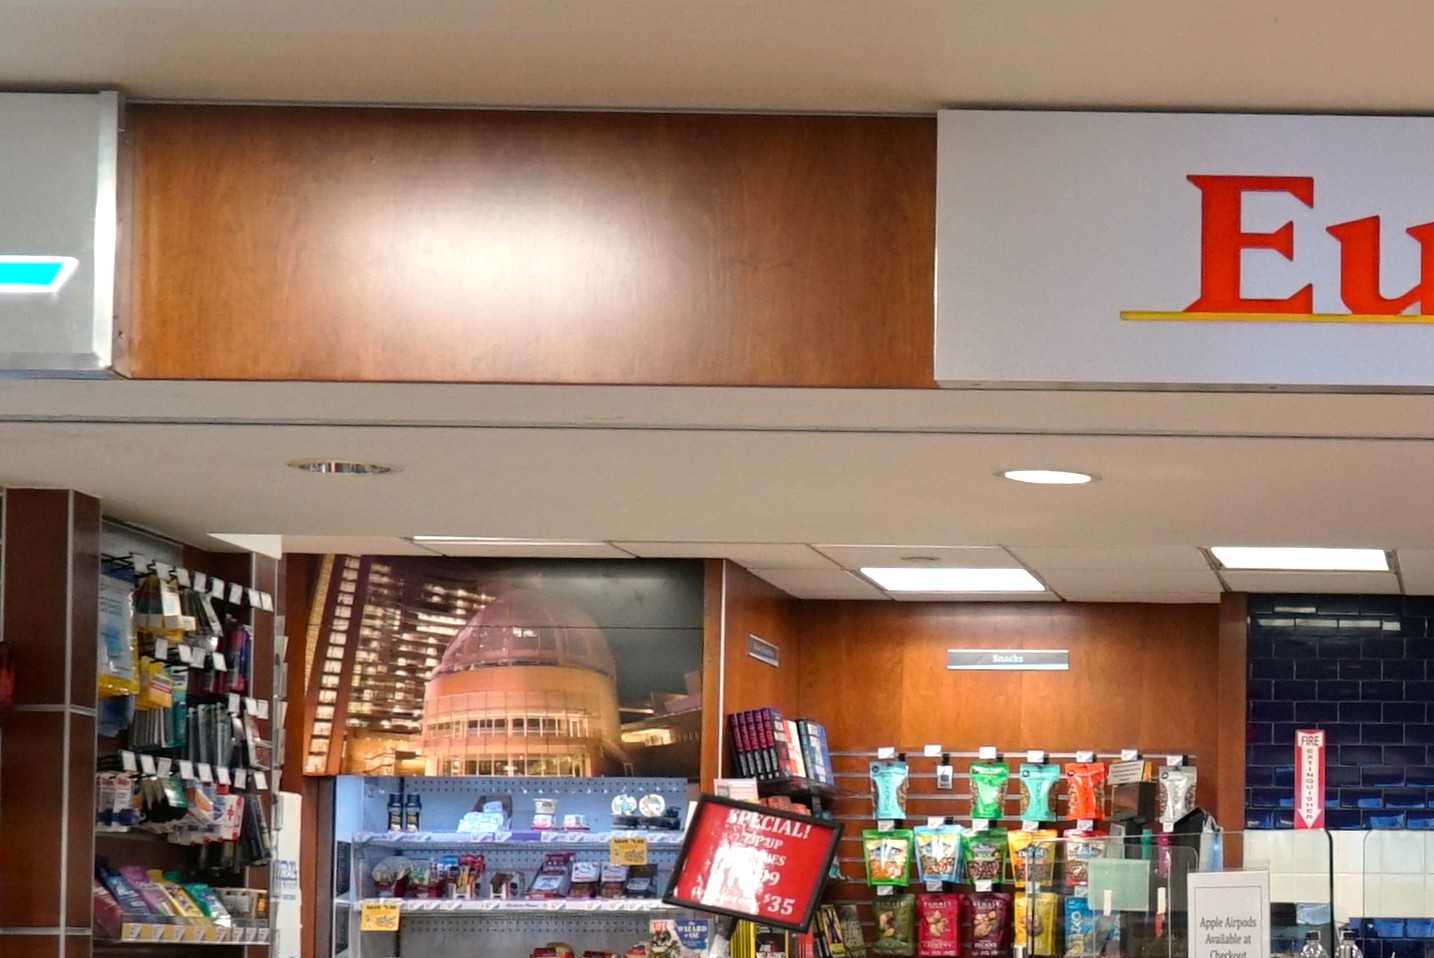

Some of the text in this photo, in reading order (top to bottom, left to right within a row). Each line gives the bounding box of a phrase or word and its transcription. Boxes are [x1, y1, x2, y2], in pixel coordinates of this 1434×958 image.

[1301, 735, 1319, 746] FIRE
[1306, 748, 1315, 820] EXTINGUISHER
[726, 808, 812, 840] SPECIAL!
[764, 893, 796, 916] $35
[1200, 917, 1257, 931] Apple Airpods
[1205, 933, 1252, 945] Available at
